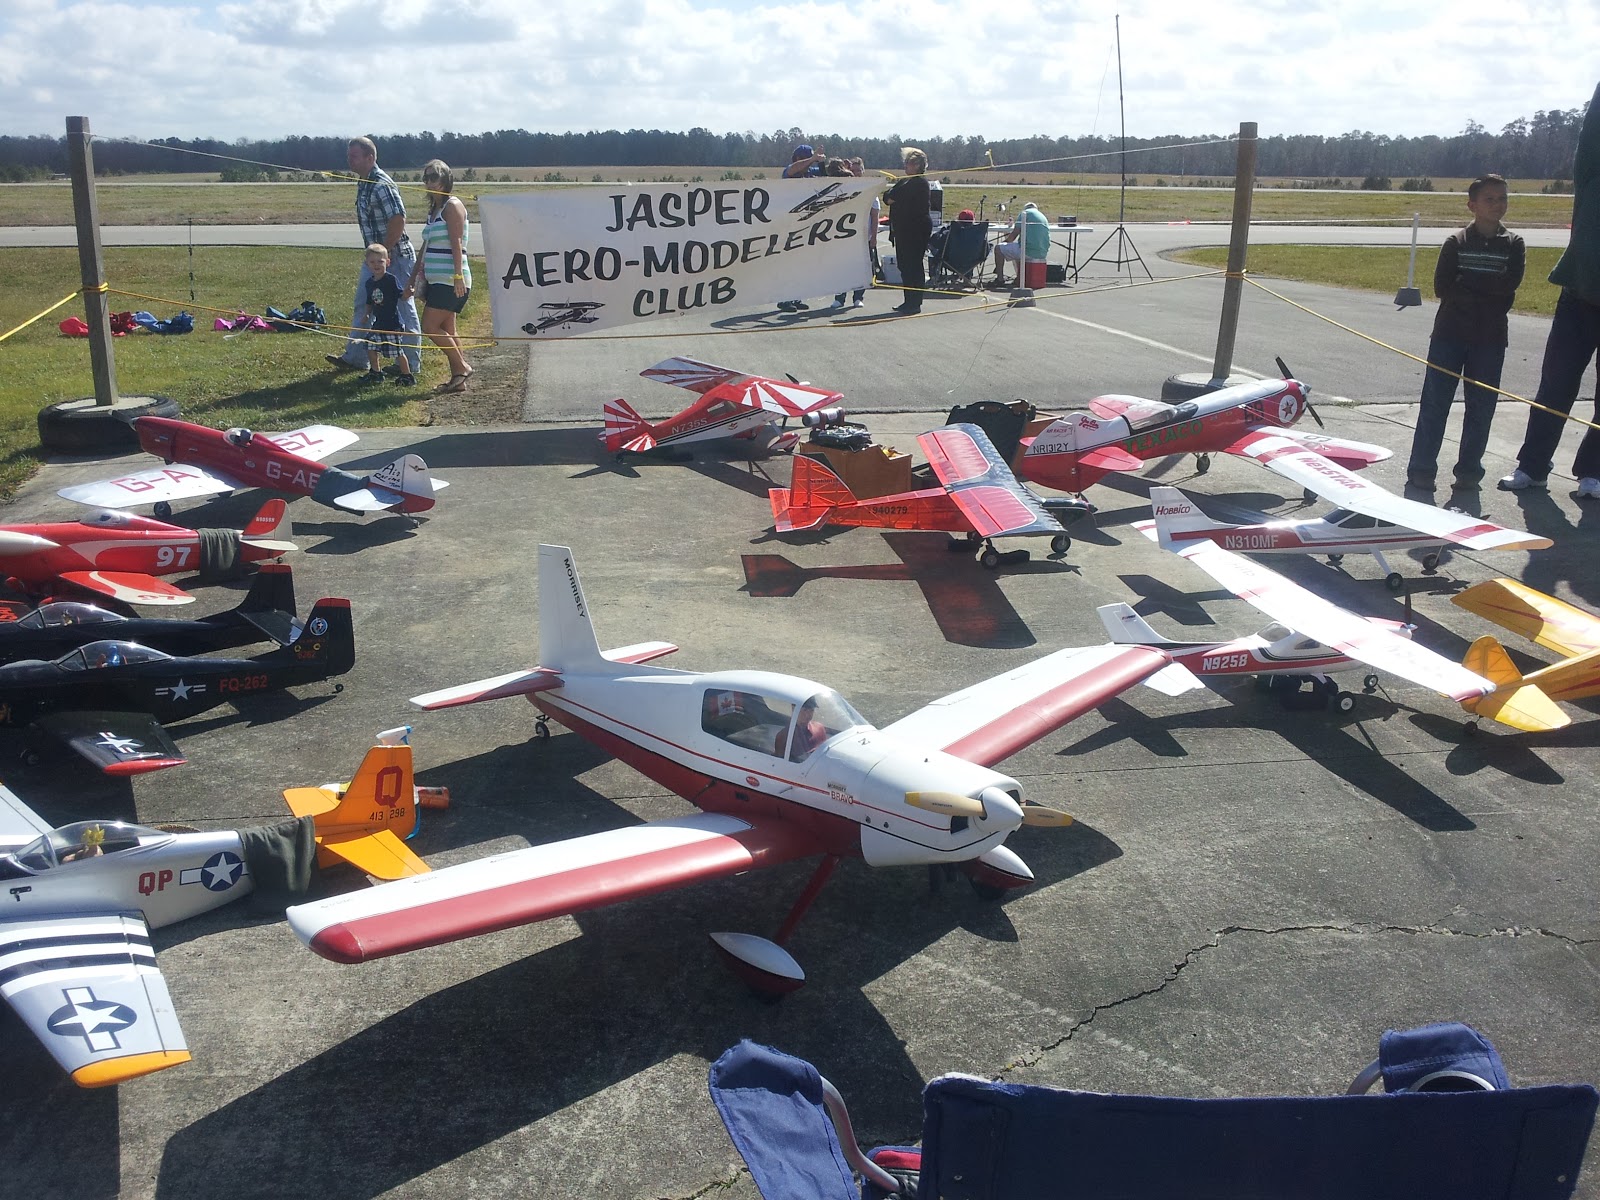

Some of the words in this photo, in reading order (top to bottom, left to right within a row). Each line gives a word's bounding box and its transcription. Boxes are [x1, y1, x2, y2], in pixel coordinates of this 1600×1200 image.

[605, 187, 772, 233] JASPER
[501, 212, 858, 290] AERO-MODELERS
[632, 276, 738, 318] CLUB
[1033, 442, 1069, 454] NR1312Y
[1125, 420, 1204, 453] TEXACO
[1225, 534, 1279, 549] N310MF
[156, 546, 192, 568] 97
[563, 557, 586, 618] MORRISEY
[219, 674, 269, 693] FQ-262
[374, 765, 404, 809] Q
[369, 811, 385, 821] 413
[389, 807, 406, 819] 298
[138, 869, 174, 897] QP
